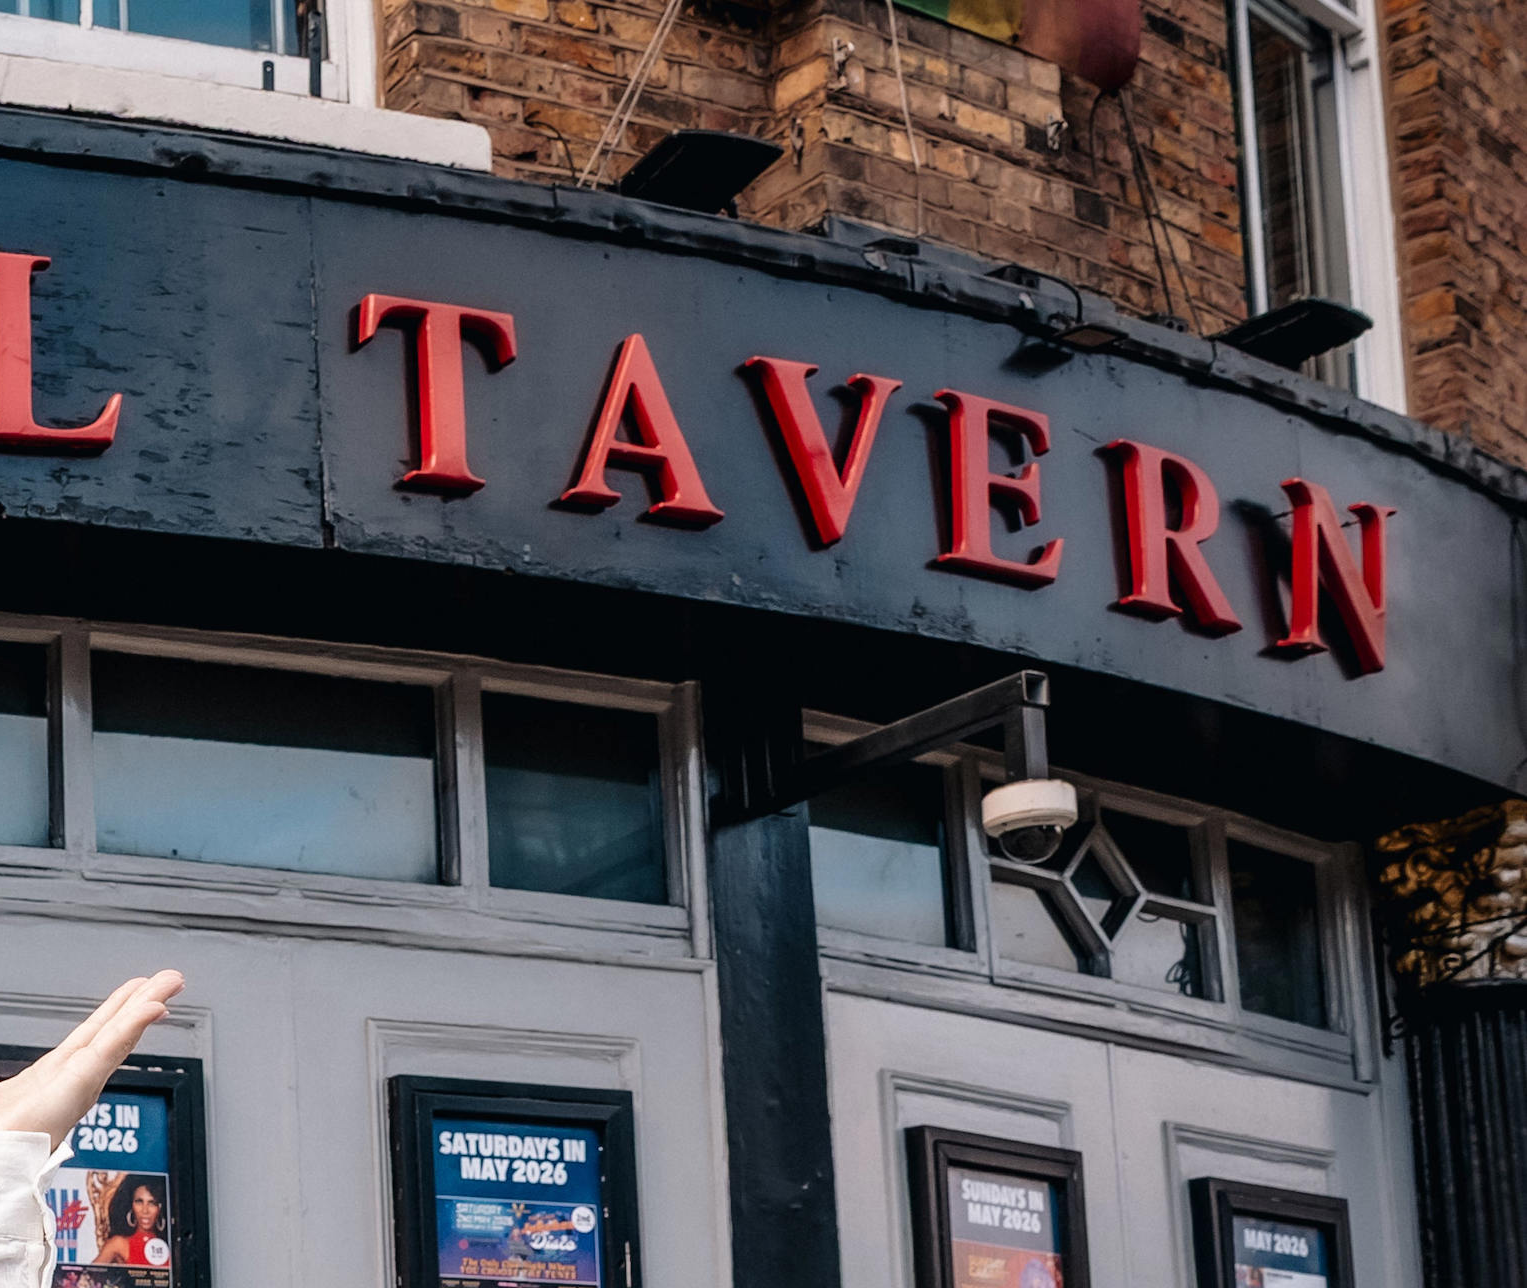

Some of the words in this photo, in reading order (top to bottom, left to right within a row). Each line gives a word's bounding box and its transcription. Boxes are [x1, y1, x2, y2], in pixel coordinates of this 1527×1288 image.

[354, 294, 1397, 674] TAVERN
[115, 1104, 140, 1129] IN
[77, 1127, 139, 1153] 2026
[439, 1131, 561, 1161] SATURDAYS
[563, 1139, 586, 1163] IN
[460, 1156, 511, 1182] MAY
[512, 1160, 568, 1185] 2026
[961, 1179, 1026, 1210] SUNDAYS
[1028, 1190, 1044, 1213] IN
[967, 1202, 1001, 1228] MAY
[1002, 1210, 1041, 1234] 2026
[1243, 1228, 1273, 1252] MAY
[1273, 1234, 1309, 1257] 2026
